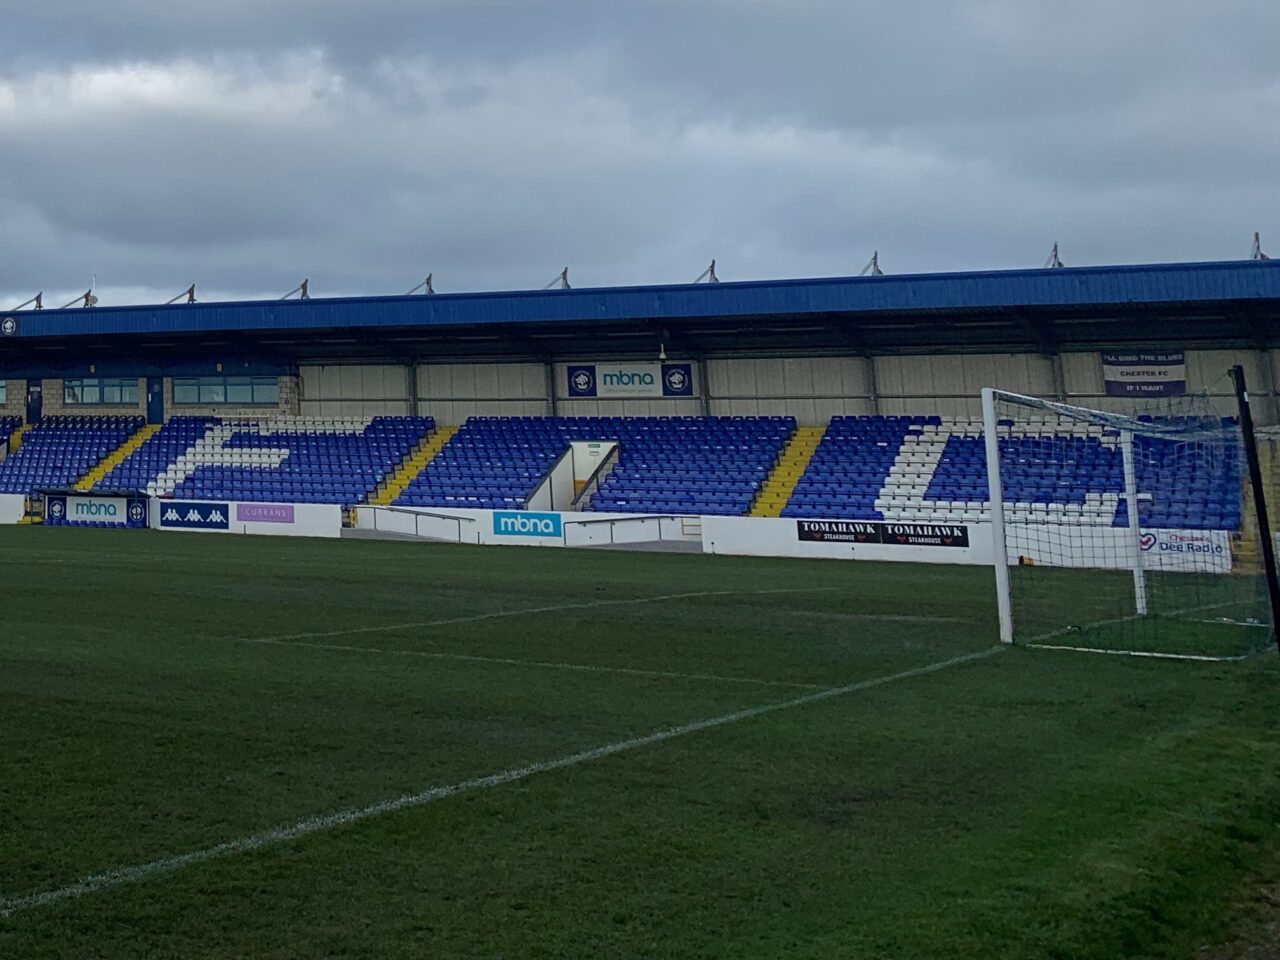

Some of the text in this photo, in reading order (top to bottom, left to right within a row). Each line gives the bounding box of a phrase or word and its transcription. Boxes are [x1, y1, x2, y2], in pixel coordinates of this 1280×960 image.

[603, 370, 655, 386] mbna
[75, 499, 117, 517] mbna
[244, 506, 287, 518] CURRANS
[499, 514, 554, 534] mbna
[801, 521, 876, 534] TOMAHAWK
[885, 524, 963, 537] TOMAHAWK
[823, 533, 855, 541] STEAKHOUSE
[908, 536, 942, 544] STEAKHOUSE
[1160, 542, 1223, 554] Dee Radio
